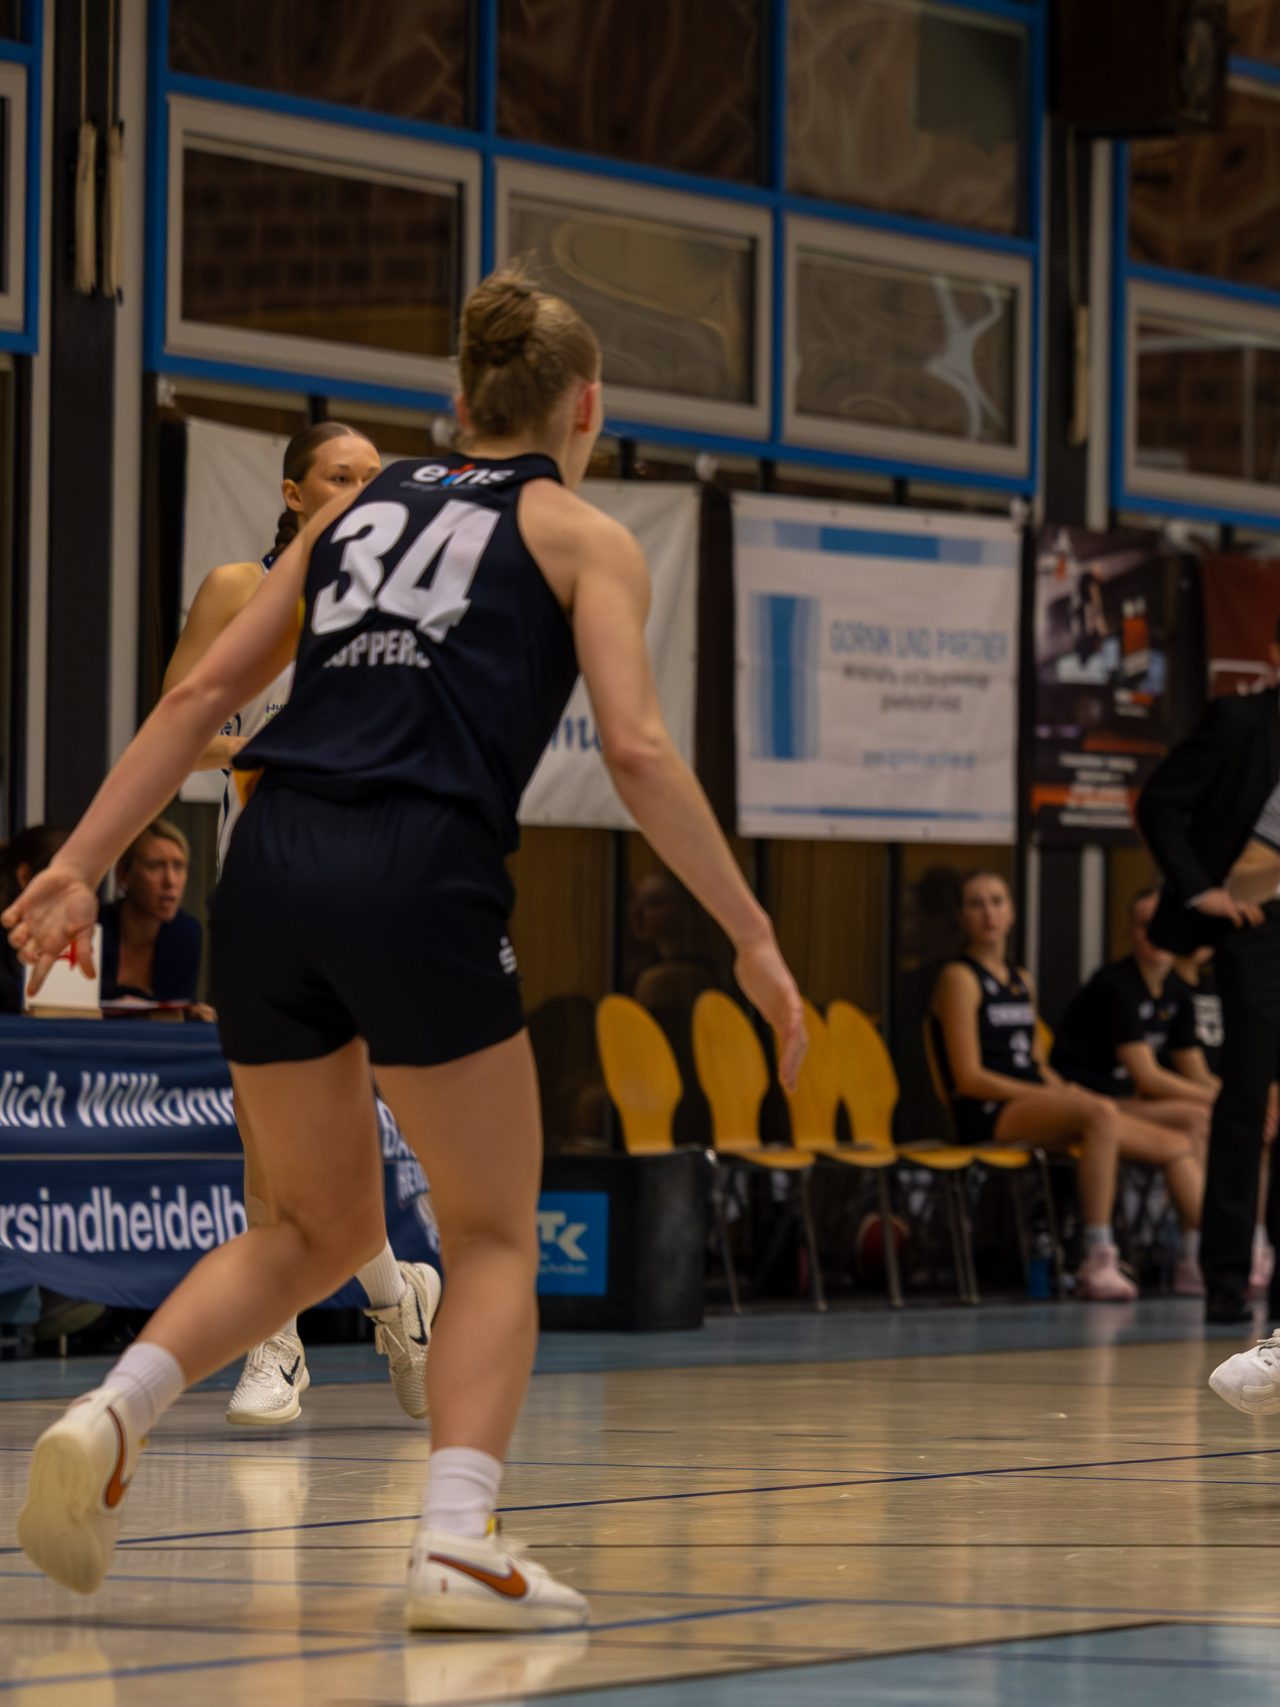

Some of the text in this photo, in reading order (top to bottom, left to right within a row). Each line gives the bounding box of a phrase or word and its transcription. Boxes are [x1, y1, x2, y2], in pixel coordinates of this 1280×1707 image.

[310, 499, 502, 645] 34
[322, 629, 432, 669] UPPER
[537, 1210, 589, 1261] TK
